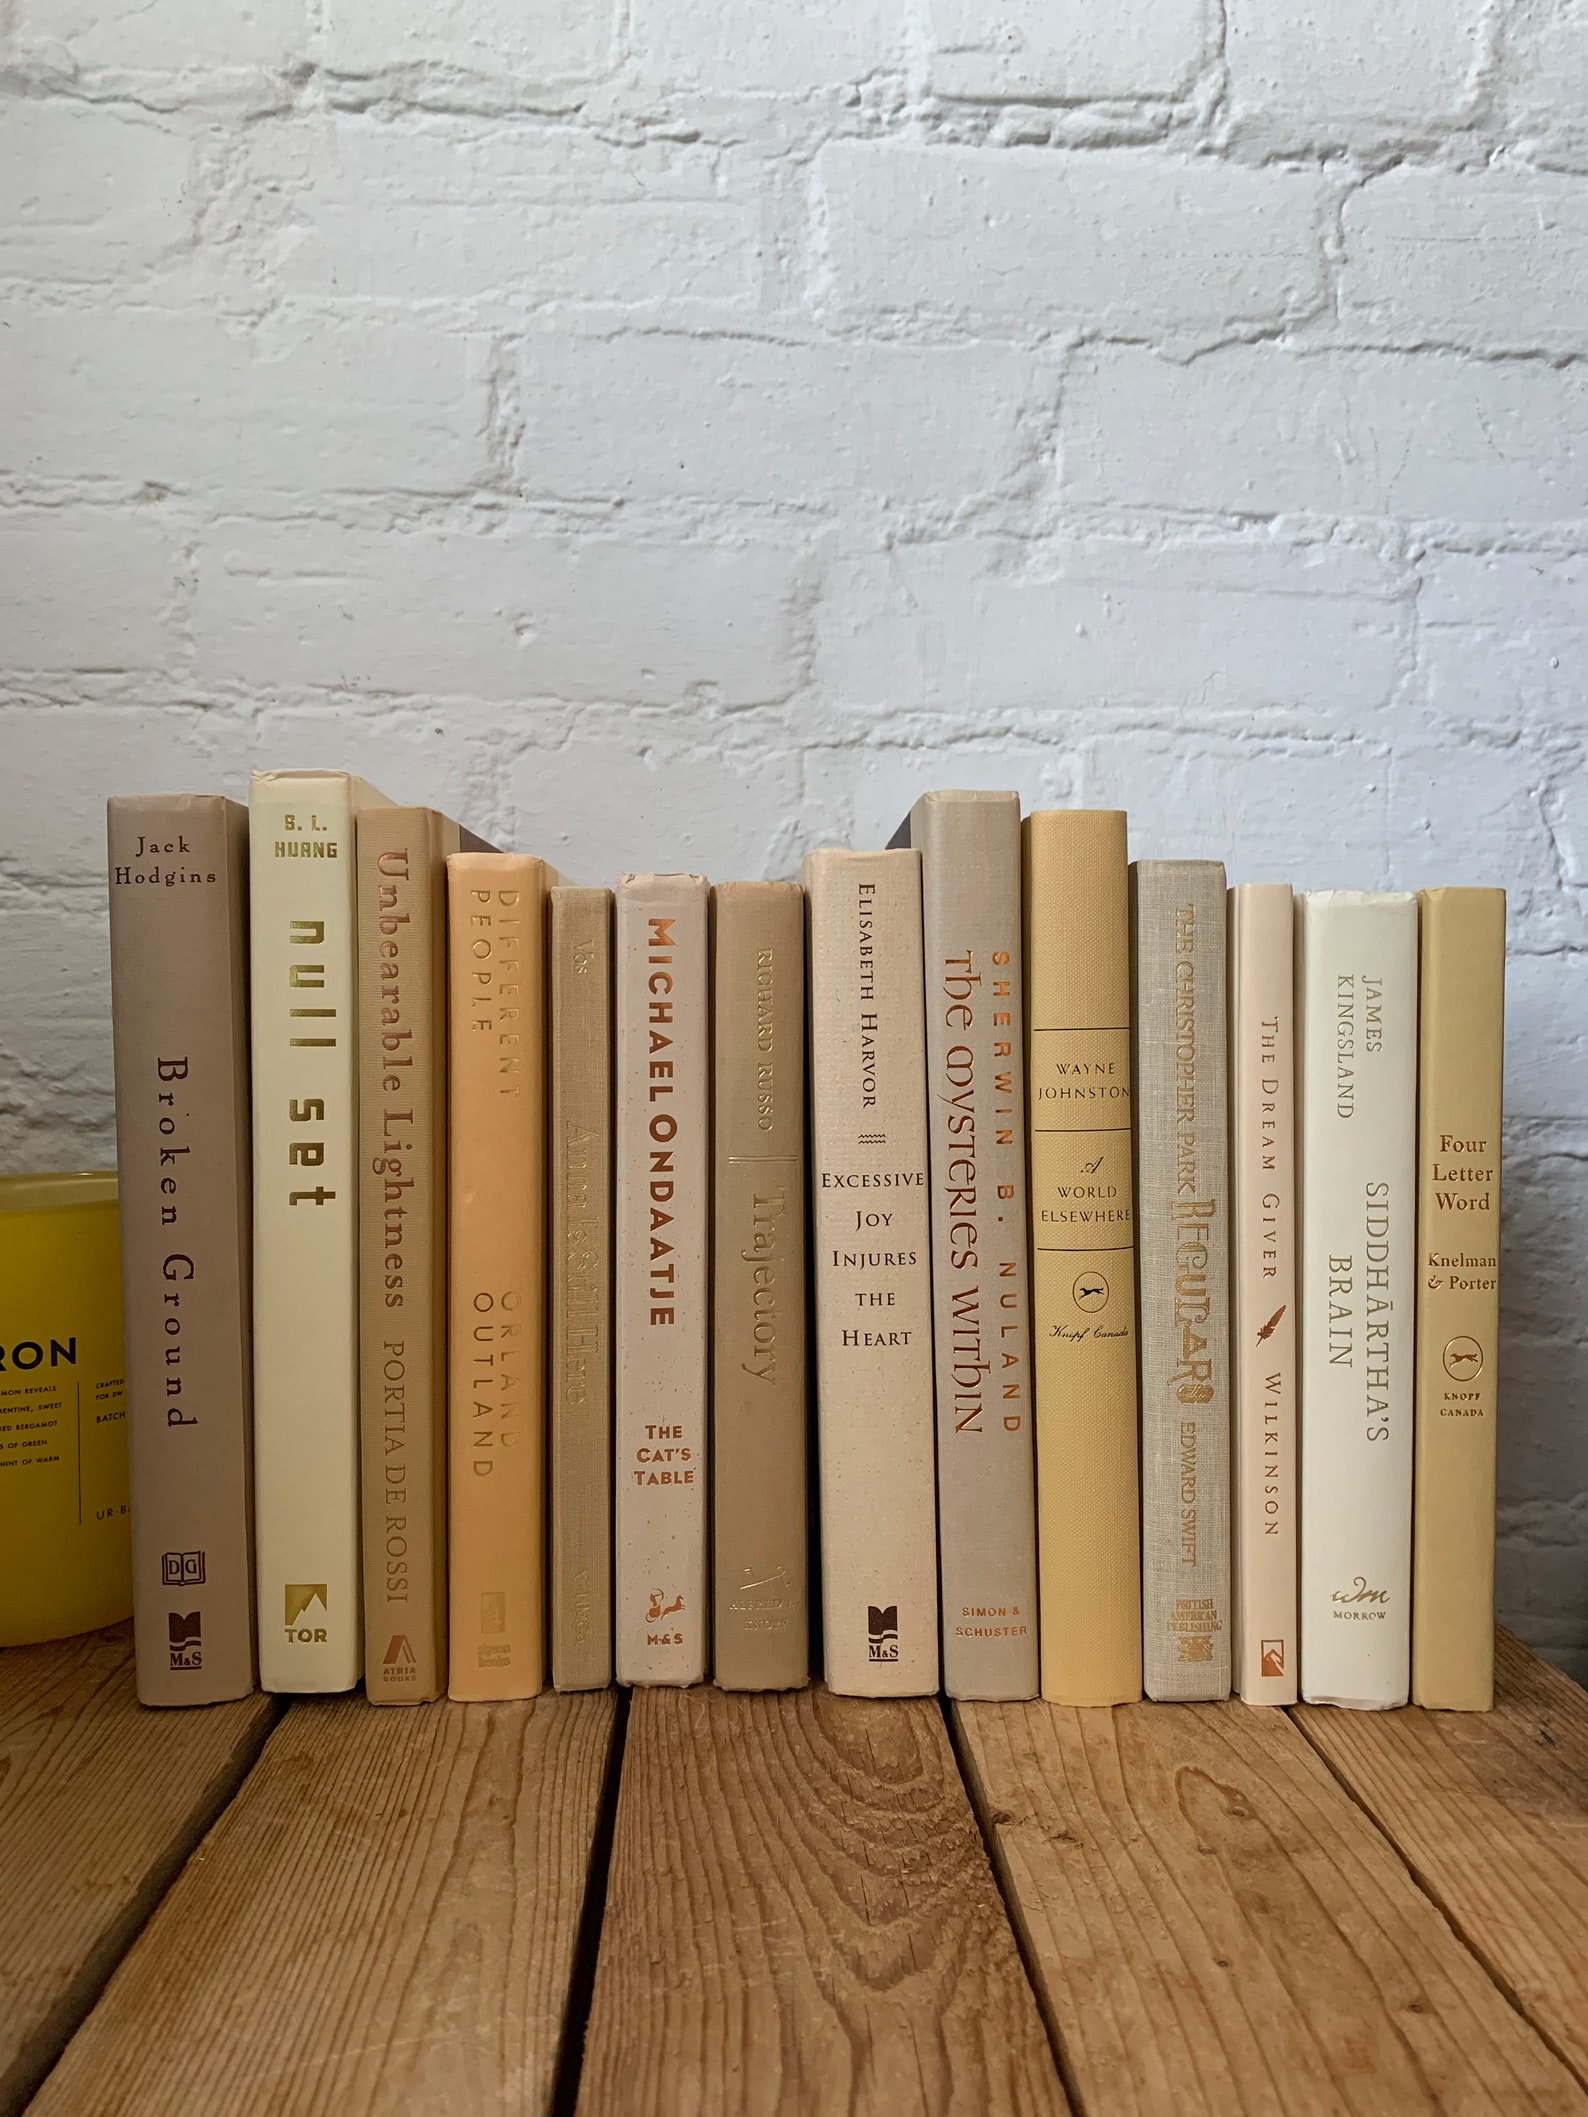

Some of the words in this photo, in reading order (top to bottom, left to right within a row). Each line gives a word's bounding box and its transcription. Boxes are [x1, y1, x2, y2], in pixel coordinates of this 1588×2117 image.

[135, 836, 191, 857] Jack
[275, 842, 338, 859] HUANG
[115, 867, 217, 887] Hodgins
[858, 883, 876, 1001] ELISABETH
[1174, 903, 1196, 955] THE
[378, 848, 413, 1092] Unbearable
[470, 890, 492, 1033] PEOPLE
[289, 920, 337, 1047] null
[498, 890, 520, 1098] DIFFERENT
[757, 947, 775, 1052] RICHARD
[942, 949, 983, 1031] The
[648, 918, 676, 1102] MICHAEL
[1361, 975, 1383, 1052] JAMES
[992, 951, 1014, 1146] SHERWIN
[1175, 960, 1197, 1125] CHRISTOPHER
[1261, 1016, 1279, 1063] THE
[1337, 974, 1355, 1119] KINGSLAND
[861, 1013, 878, 1109] HARVOR
[1056, 1063, 1116, 1075] WAYNE
[757, 1061, 774, 1132] RUSSO
[1038, 1086, 1130, 1100] JOHNSTON
[157, 1056, 191, 1226] Broken
[1262, 1078, 1280, 1170] DREAM
[289, 1098, 337, 1206] set
[1177, 1132, 1197, 1194] PARK
[1439, 1135, 1488, 1153] Four
[822, 1172, 925, 1189] EXCESSIVE
[1432, 1164, 1494, 1182] Letter
[373, 1108, 414, 1308] Lightness
[996, 1184, 1015, 1222] B.
[1057, 1186, 1117, 1199] WORLD
[1435, 1192, 1491, 1211] Word
[648, 1113, 678, 1326] ONDAATJE
[855, 1211, 894, 1232] JOY
[1041, 1209, 1131, 1223] ELSEWHERE
[1262, 1193, 1280, 1279] GIVER
[832, 1250, 918, 1270] INJURES
[1428, 1252, 1498, 1268] Knelman
[741, 1185, 786, 1386] Trajectory
[855, 1292, 896, 1306] THE
[1449, 1275, 1497, 1291] Porter
[1328, 1254, 1354, 1368] BRAIN
[162, 1253, 198, 1428] Ground
[841, 1329, 912, 1347] HEART
[999, 1261, 1022, 1433] NULAND
[472, 1292, 494, 1478] OUTLAND
[500, 1290, 522, 1448] ORLAND
[25, 1385, 57, 1395] REVEALS
[38, 1402, 63, 1411] SWEET
[384, 1341, 406, 1456] PORTIA
[1444, 1392, 1481, 1402] KNOPF
[16, 1420, 58, 1431] BERGAMOT
[96, 1411, 126, 1424] BATCH
[645, 1424, 683, 1440] THE
[1440, 1408, 1485, 1418] CANADA
[22, 1439, 48, 1448] GREEN
[36, 1456, 60, 1464] WARM
[636, 1447, 692, 1464] CAT'S
[1179, 1421, 1196, 1504] EDWARD
[1264, 1372, 1282, 1536] WILKINSON
[385, 1466, 407, 1505] DE
[634, 1470, 694, 1486] TABLE
[1180, 1508, 1197, 1567] SWIFT
[385, 1516, 408, 1604] ROSSI
[962, 1607, 1007, 1617] SIMON
[1012, 1606, 1021, 1616] &
[1333, 1611, 1386, 1620] MORROW
[285, 1628, 328, 1643] TOR
[956, 1626, 1028, 1637] SCHUSTER
[170, 1651, 203, 1666] M&S
[383, 1666, 417, 1675] ATRIA
[868, 1645, 899, 1658] M&S
